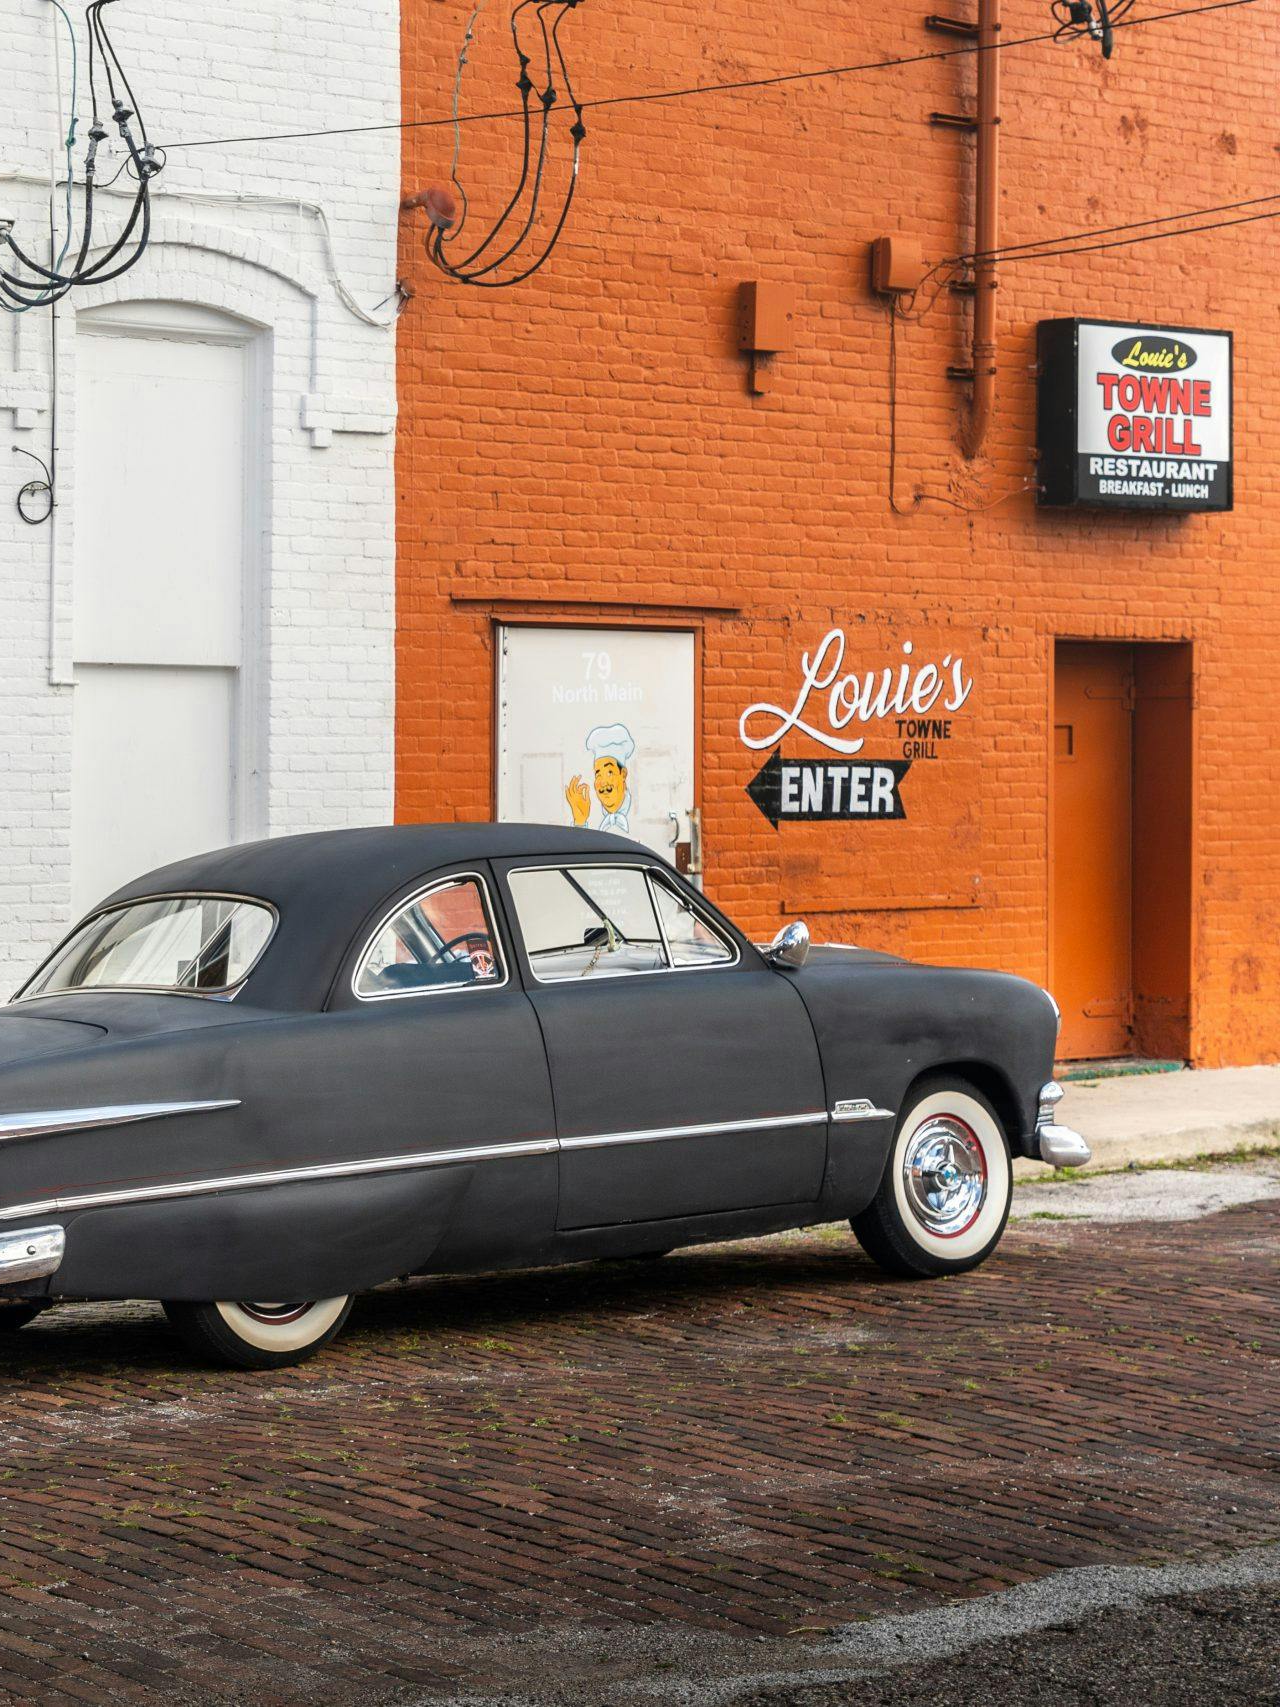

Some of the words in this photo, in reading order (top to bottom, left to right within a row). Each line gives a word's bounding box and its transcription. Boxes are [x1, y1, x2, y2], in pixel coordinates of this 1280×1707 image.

[1123, 341, 1187, 368] Louie's
[1097, 373, 1211, 417] TOWNE
[1108, 414, 1201, 456] GRILL
[1090, 457, 1217, 481] RESTAURANT
[1099, 480, 1164, 496] BREAKFAST
[1172, 483, 1209, 498] LUNCH
[582, 652, 611, 680] 79
[552, 684, 598, 702] North
[604, 682, 642, 702] Main
[739, 628, 973, 754] Louie's
[895, 719, 952, 739] TOWNE
[903, 742, 938, 759] GRILL
[781, 767, 895, 813] ENTER
